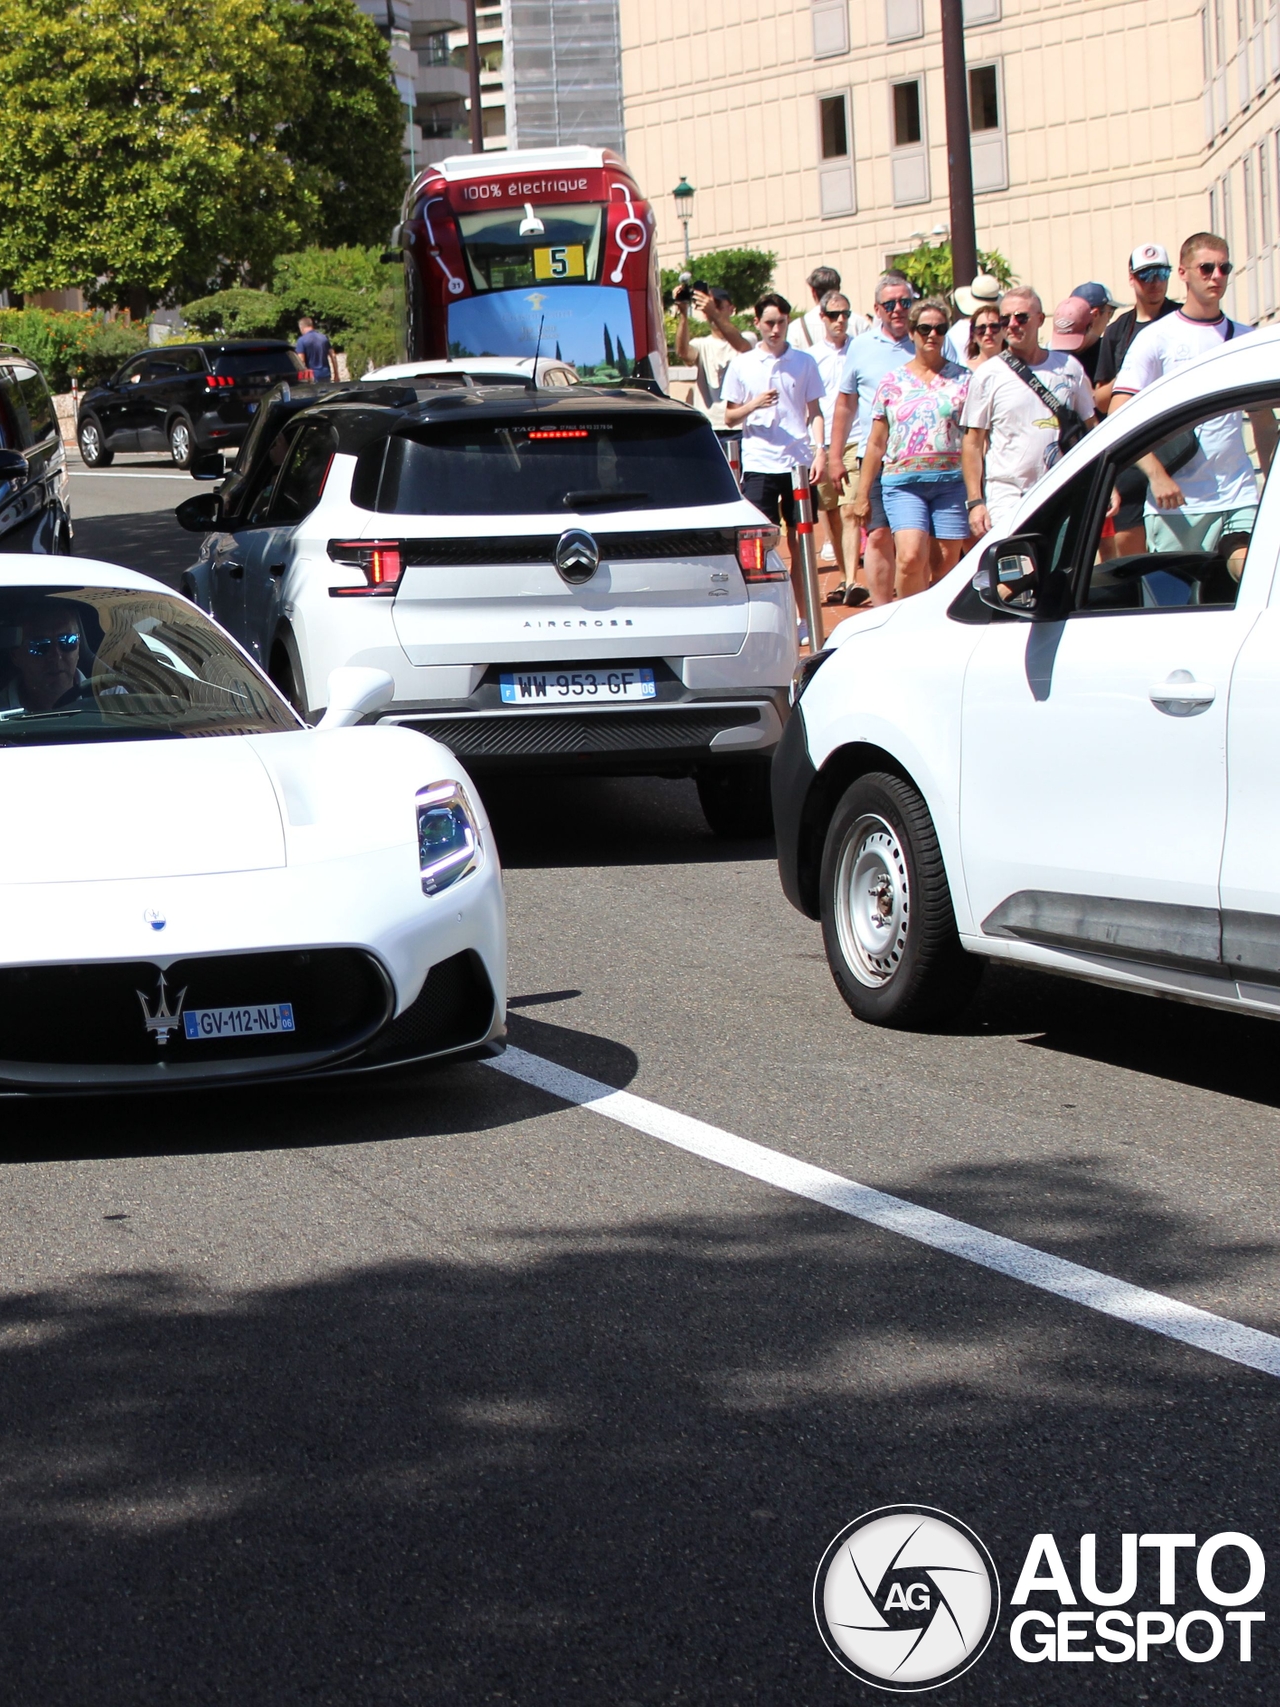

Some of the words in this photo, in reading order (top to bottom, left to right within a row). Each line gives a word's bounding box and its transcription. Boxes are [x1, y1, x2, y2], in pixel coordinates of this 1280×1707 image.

[464, 184, 503, 200] 100%
[508, 178, 588, 196] électrique
[550, 246, 569, 278] 5
[451, 282, 461, 291] 31
[523, 619, 634, 628] AIRCROSS
[642, 683, 655, 695] 06
[200, 1007, 279, 1035] GV-112-NJ
[282, 1018, 293, 1028] 06
